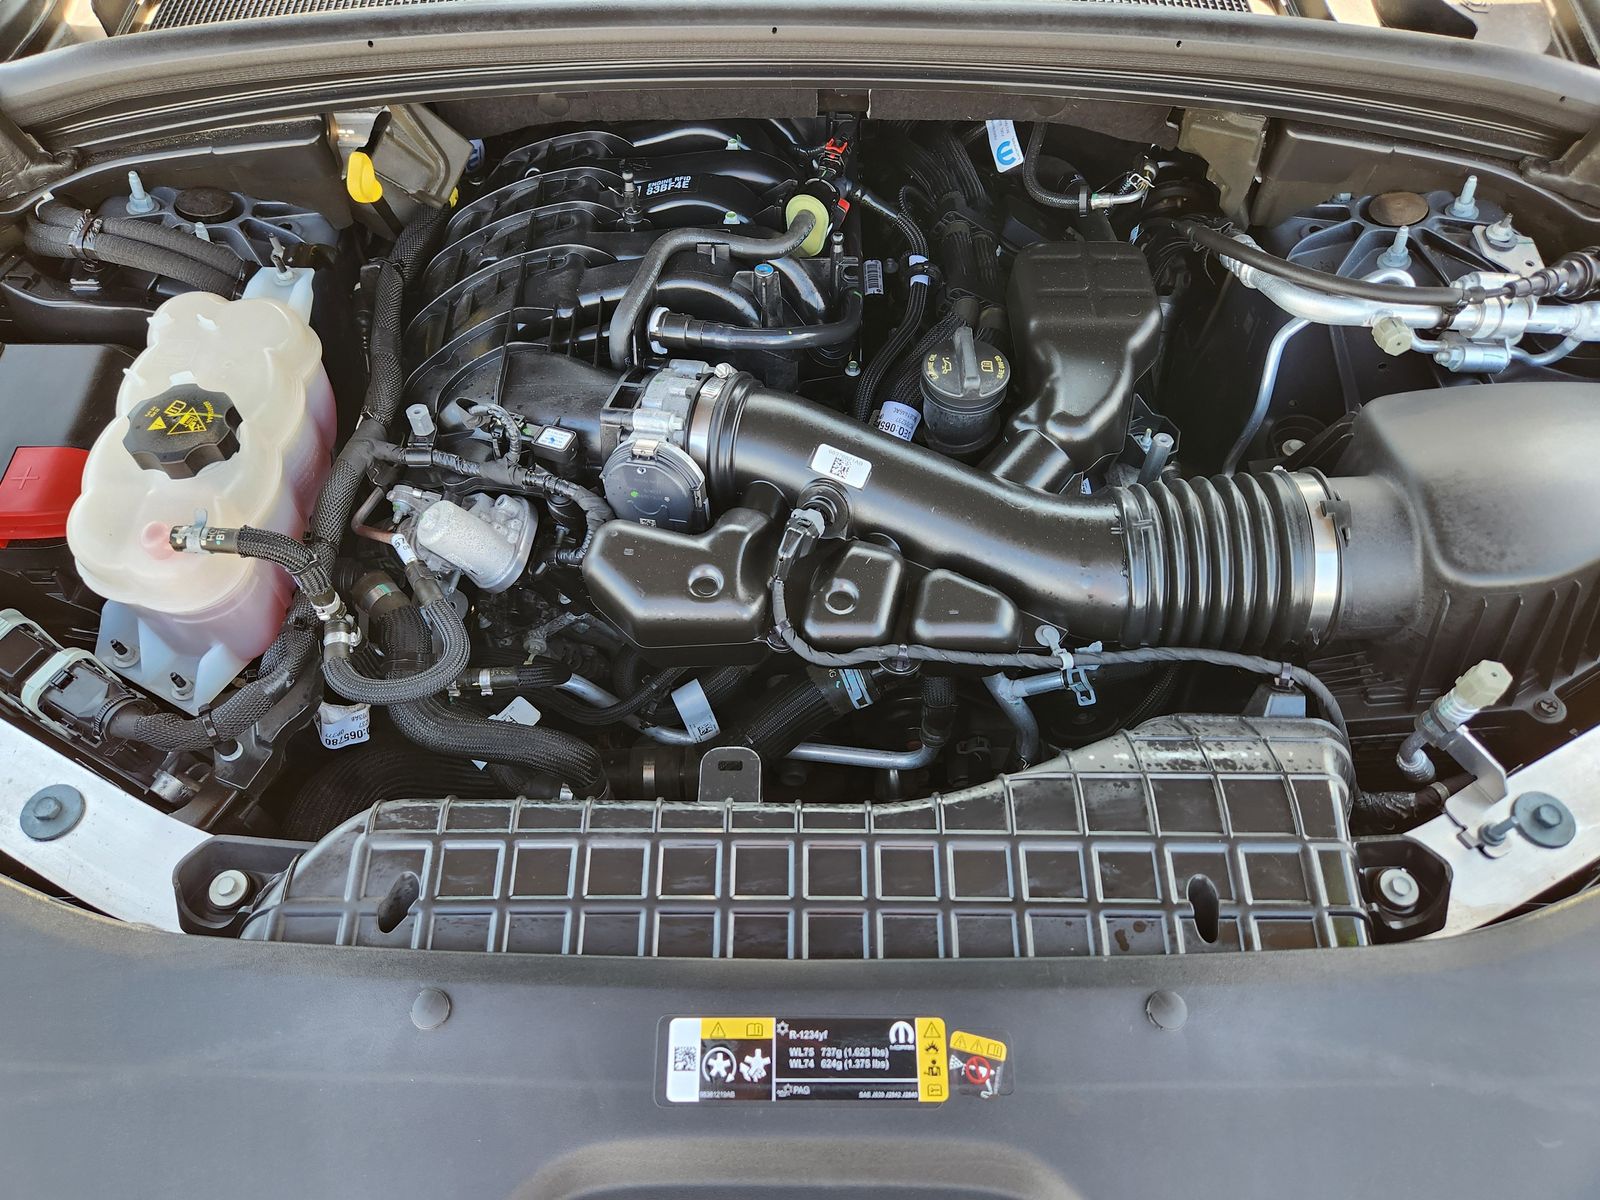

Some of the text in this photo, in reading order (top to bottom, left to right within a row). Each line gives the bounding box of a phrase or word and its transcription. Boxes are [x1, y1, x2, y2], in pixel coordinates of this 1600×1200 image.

[646, 181, 690, 195] 83BF4E
[648, 178, 673, 188] ENGINE
[789, 1030, 828, 1042] R-1234yf
[820, 1047, 843, 1059] 737g
[844, 1047, 871, 1059] (1.625
[871, 1047, 890, 1059] lbs)
[788, 1058, 890, 1071] WL74 624g (1.375 lbs)
[793, 1085, 811, 1095] PAG
